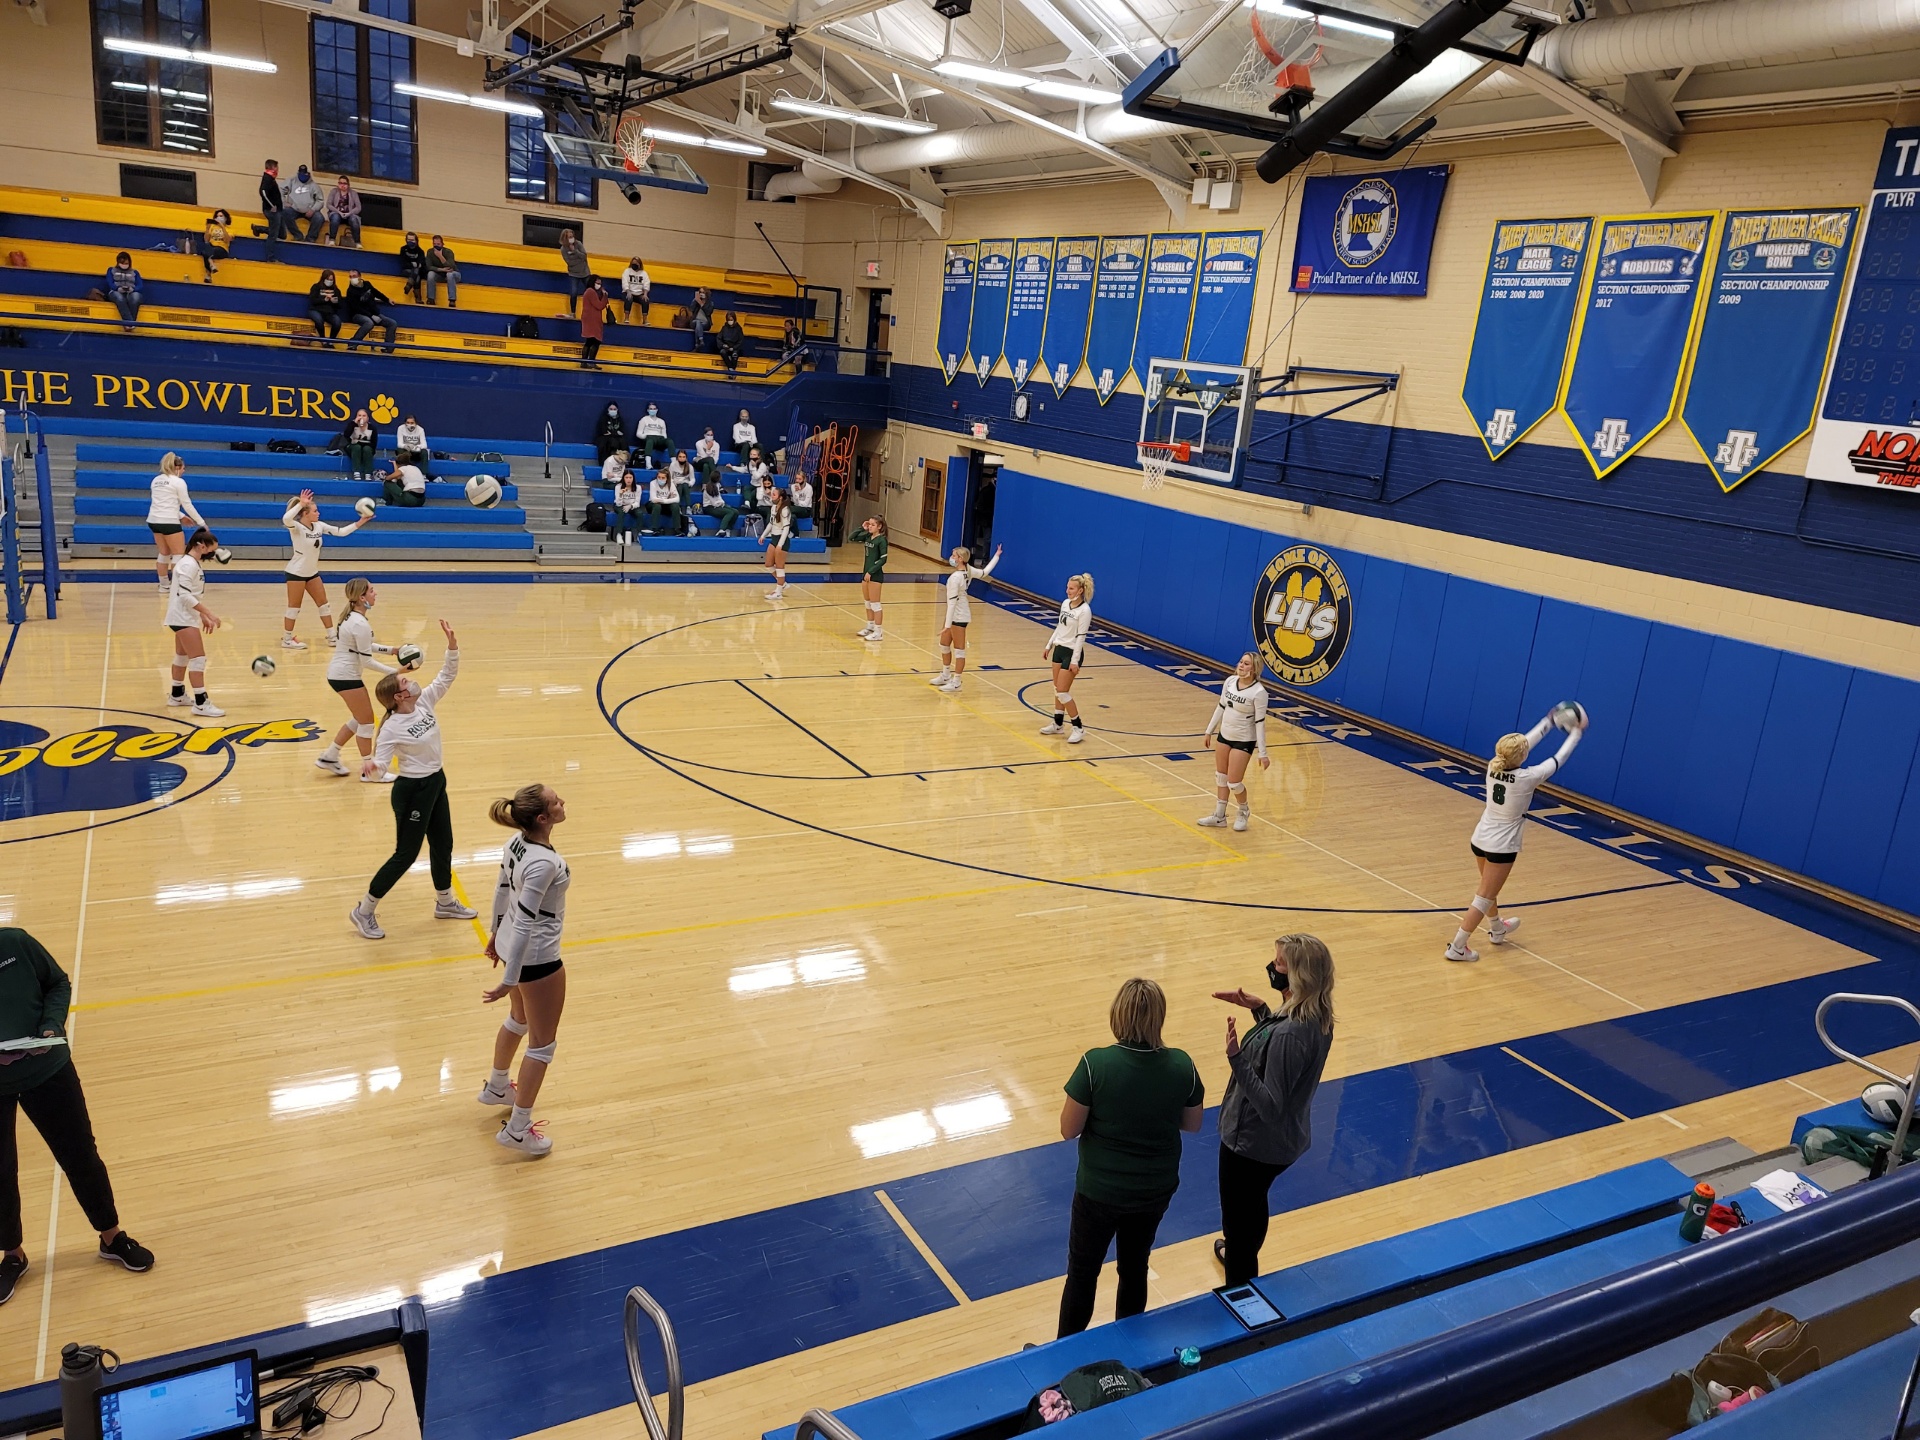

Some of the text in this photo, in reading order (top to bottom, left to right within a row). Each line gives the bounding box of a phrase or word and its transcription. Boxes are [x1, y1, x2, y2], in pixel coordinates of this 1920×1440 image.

[1884, 191, 1916, 208] PLYR
[1348, 212, 1382, 234] MSHSL
[1727, 213, 1851, 251] THIEF RIVER FALLS
[1602, 225, 1638, 257] THIEF
[1634, 223, 1672, 247] RIVER
[1522, 247, 1551, 259] MATH
[1755, 243, 1811, 257] KNOWLEDGE
[1156, 262, 1186, 272] BASEBALL
[1212, 260, 1244, 271] FOOTBALL
[1516, 259, 1553, 271] LEAGUE
[1621, 260, 1674, 275] ROBOTICS
[1765, 256, 1794, 269] BOWL
[1312, 271, 1335, 284] Proud
[1335, 271, 1365, 284] Partner
[1365, 271, 1375, 285] of
[1375, 271, 1388, 285] the
[1389, 271, 1420, 285] MSHSL
[1491, 277, 1572, 286] SECTION CHAMPIONSHIP
[1720, 280, 1829, 290] SECTION CHAMPIONSHIP
[1490, 290, 1507, 299] 1992
[1527, 290, 1545, 299] 2020
[1597, 284, 1690, 294] SECTION CHAMPIONSHIP
[1718, 294, 1741, 304] 2009
[93, 374, 351, 422] PROWLERS
[313, 539, 320, 549] 4
[1266, 549, 1347, 601] HOME OF THE
[1263, 591, 1338, 641] LHS
[1259, 639, 1330, 683] PROWLERS
[406, 712, 434, 737] ROSEA
[1492, 783, 1507, 805] 8
[1692, 1203, 1708, 1216] G
